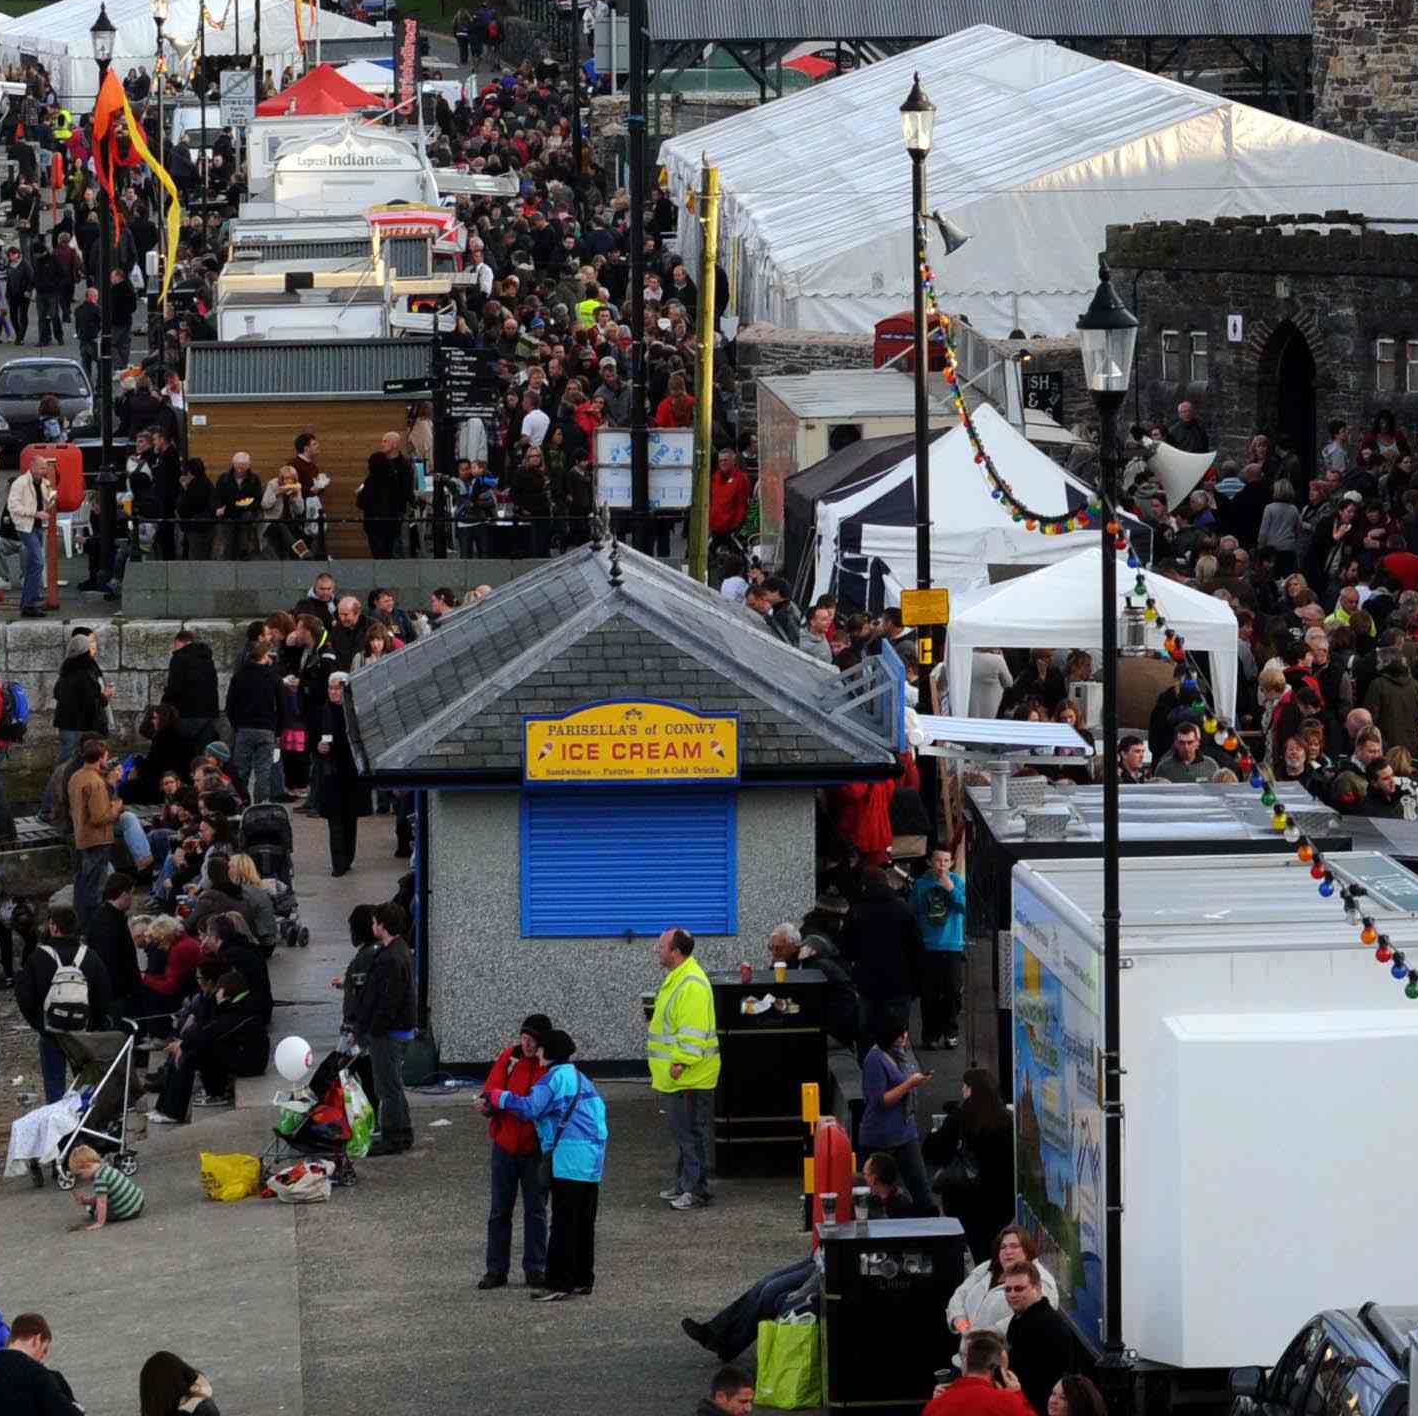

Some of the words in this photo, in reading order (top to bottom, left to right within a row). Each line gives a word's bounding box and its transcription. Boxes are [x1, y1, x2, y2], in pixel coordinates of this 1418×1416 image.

[328, 153, 374, 166] Indian
[548, 725, 637, 736] PARISELLA'S
[644, 724, 657, 735] of
[664, 723, 717, 735] CONWY
[561, 742, 600, 761] ICE
[612, 741, 702, 760] CREAM
[546, 767, 591, 776] Sandwiches
[646, 767, 661, 775] Hot
[693, 766, 720, 774] Drinks
